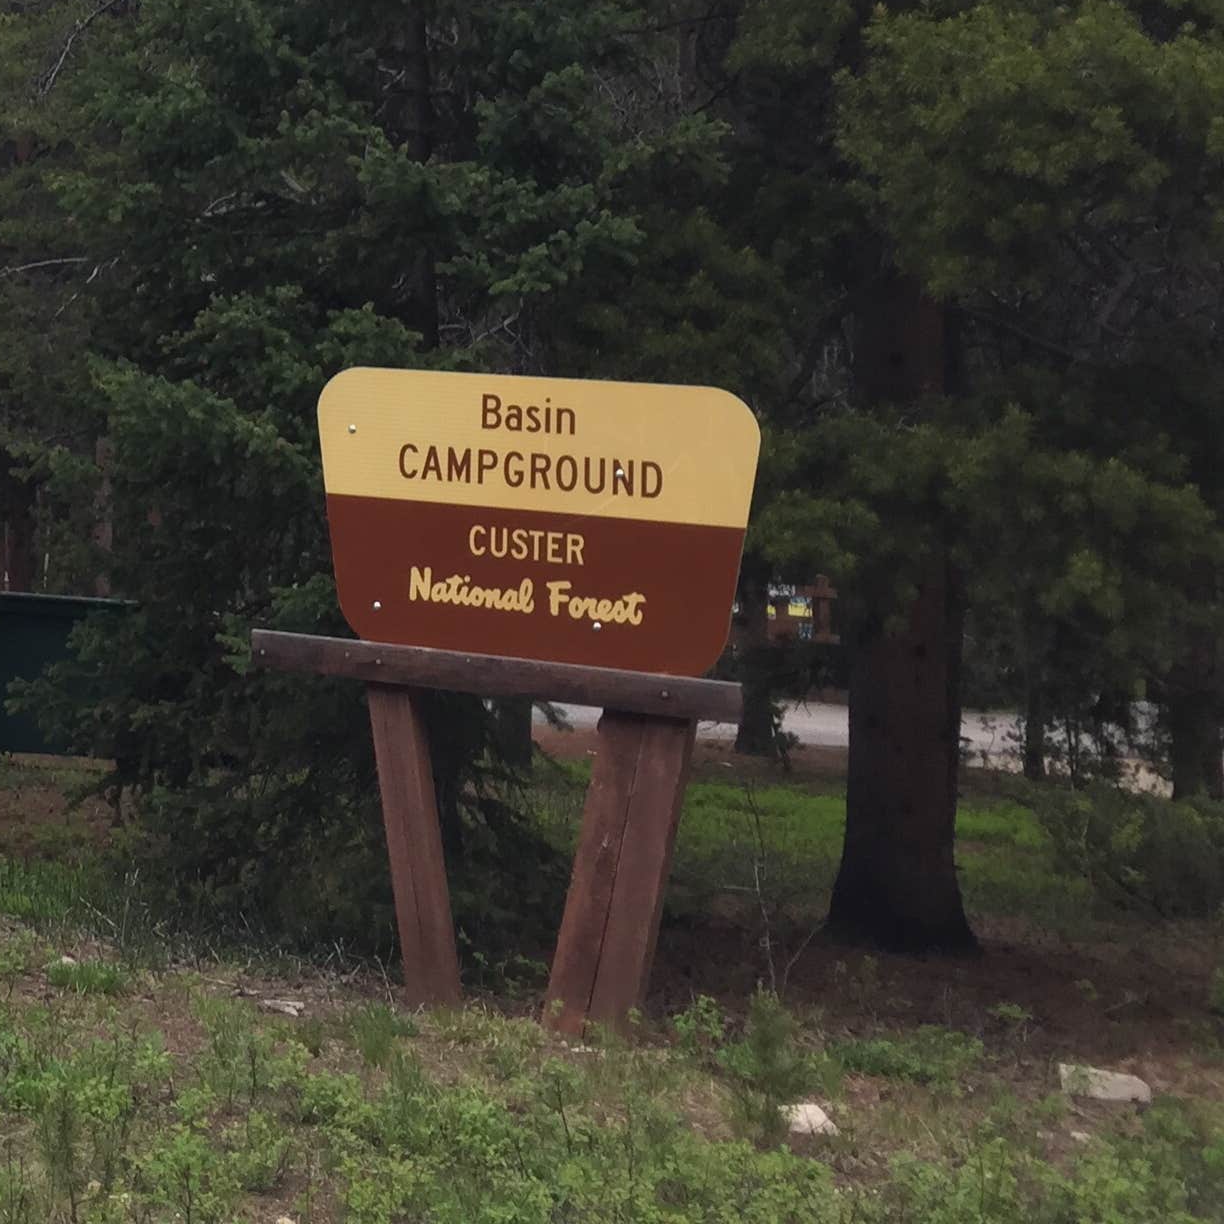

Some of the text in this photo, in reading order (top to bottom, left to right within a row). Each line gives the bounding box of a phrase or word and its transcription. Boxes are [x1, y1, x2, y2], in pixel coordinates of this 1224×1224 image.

[481, 393, 576, 435] Basin
[398, 444, 663, 498] CAMPGROUND
[469, 525, 585, 565] CUSTER
[409, 566, 646, 626] National Forest
